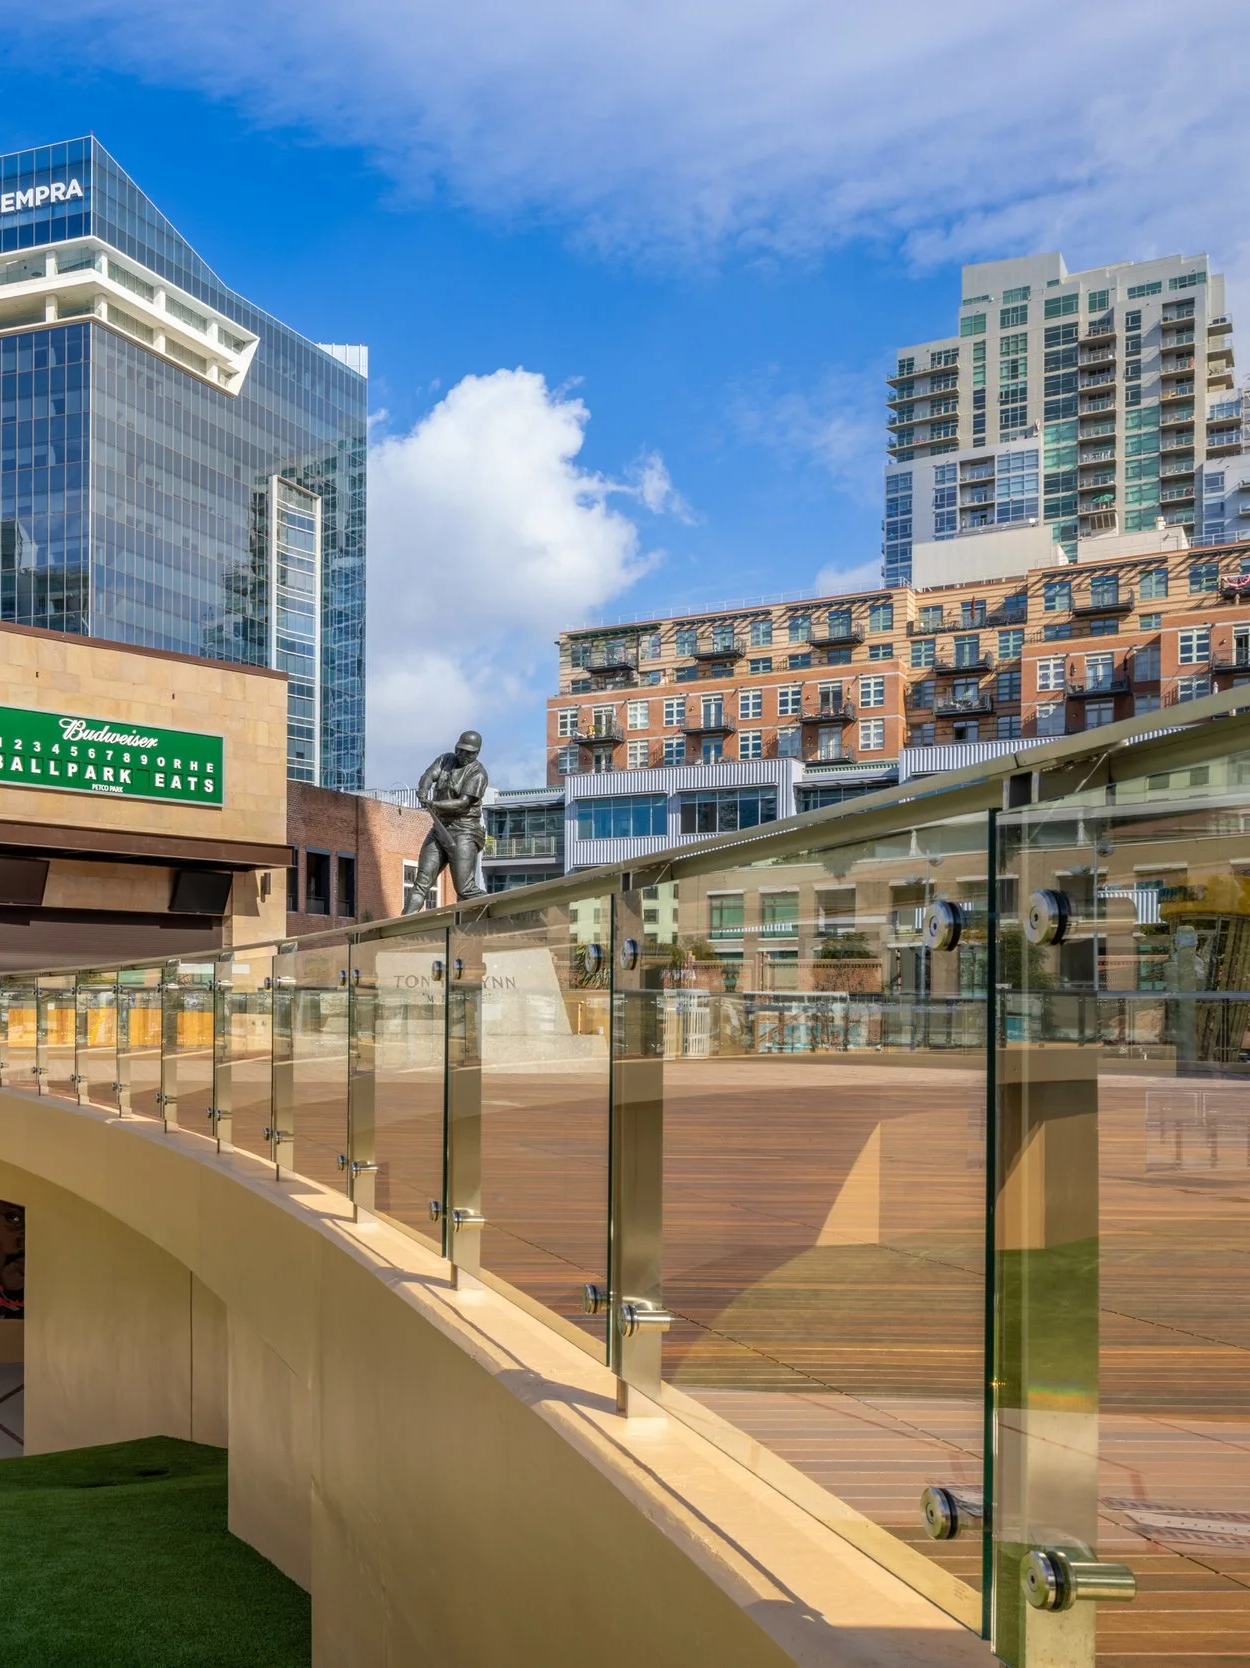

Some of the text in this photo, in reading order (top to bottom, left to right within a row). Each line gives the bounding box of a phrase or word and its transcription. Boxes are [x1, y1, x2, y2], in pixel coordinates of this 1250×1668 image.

[59, 718, 158, 748] Budweiser
[14, 739, 22, 750] 2
[33, 741, 41, 752] 3
[51, 744, 60, 754] 4
[70, 746, 78, 756] 5
[88, 748, 95, 759] 6
[106, 750, 113, 761] 7
[123, 753, 131, 763] 8
[140, 755, 148, 765] 9
[174, 759, 181, 769] R
[190, 761, 198, 771] H
[207, 763, 214, 773] E
[155, 773, 214, 793] EATS
